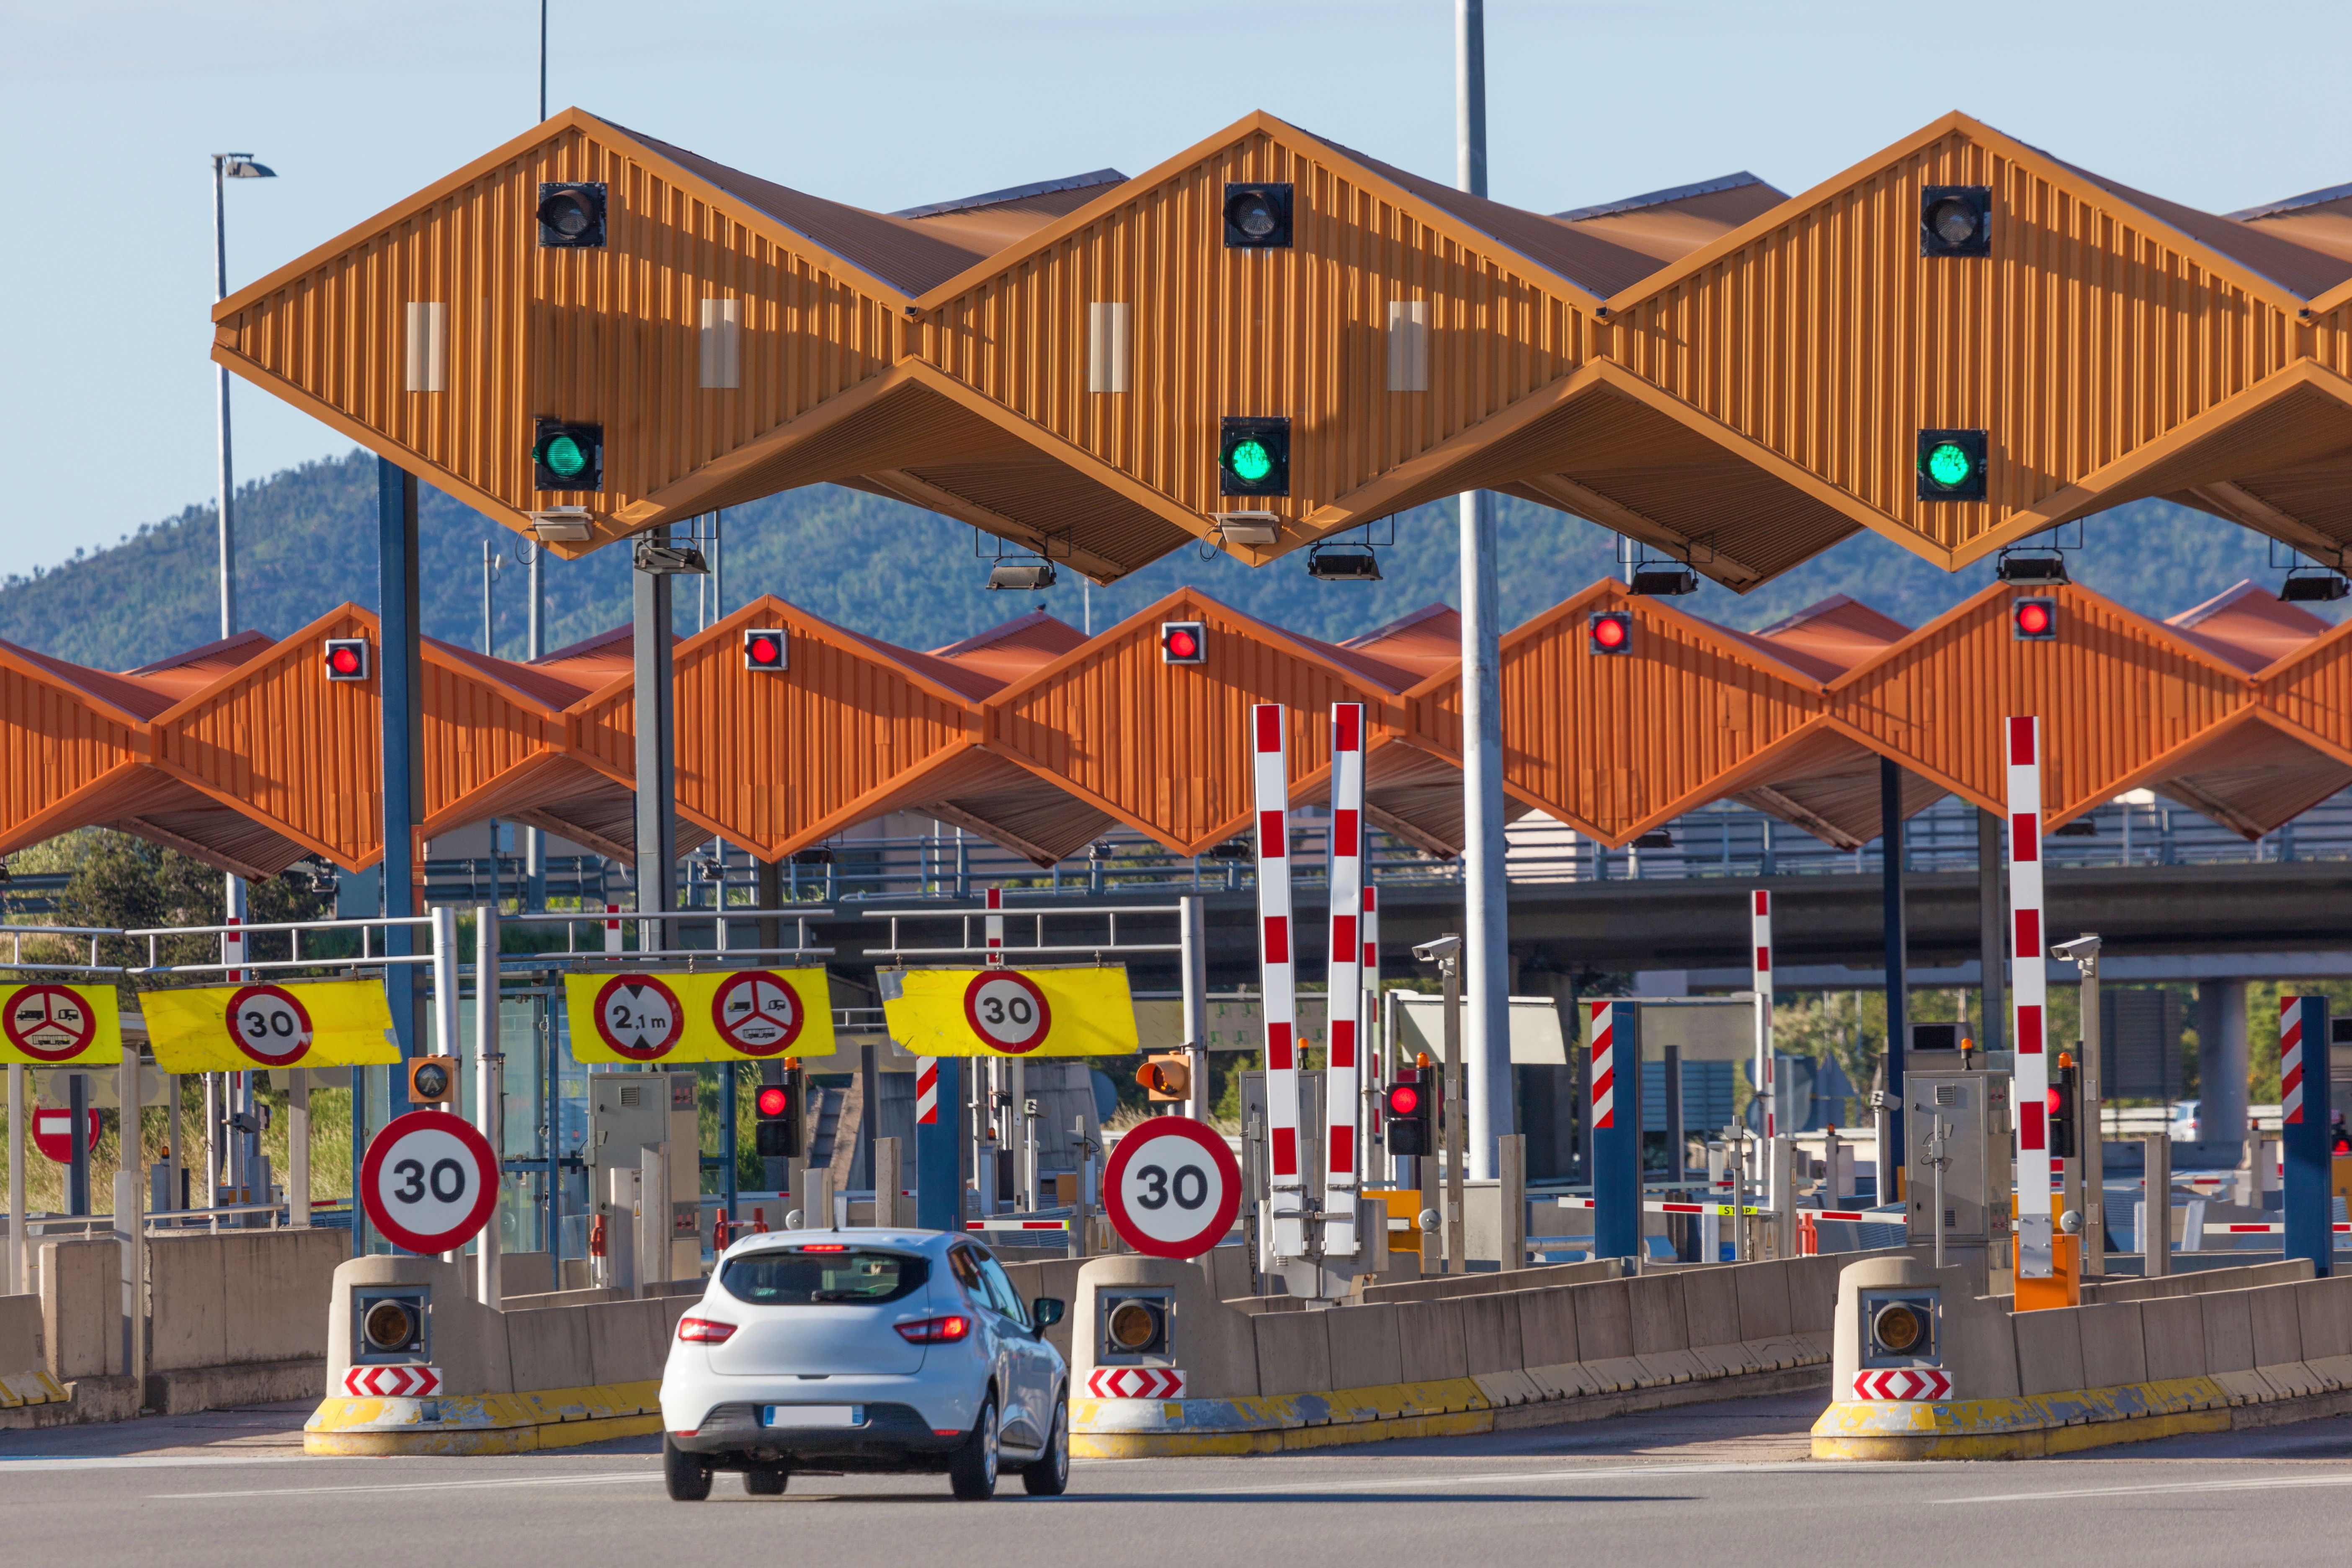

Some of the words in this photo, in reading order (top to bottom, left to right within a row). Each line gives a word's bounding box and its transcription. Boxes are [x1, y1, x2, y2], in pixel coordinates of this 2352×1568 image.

[613, 1005, 645, 1030] 2,1
[651, 1018, 666, 1028] m
[983, 997, 1032, 1024] 30
[245, 1011, 294, 1038] 30
[394, 1158, 465, 1204] 30
[1136, 1164, 1208, 1210] 30
